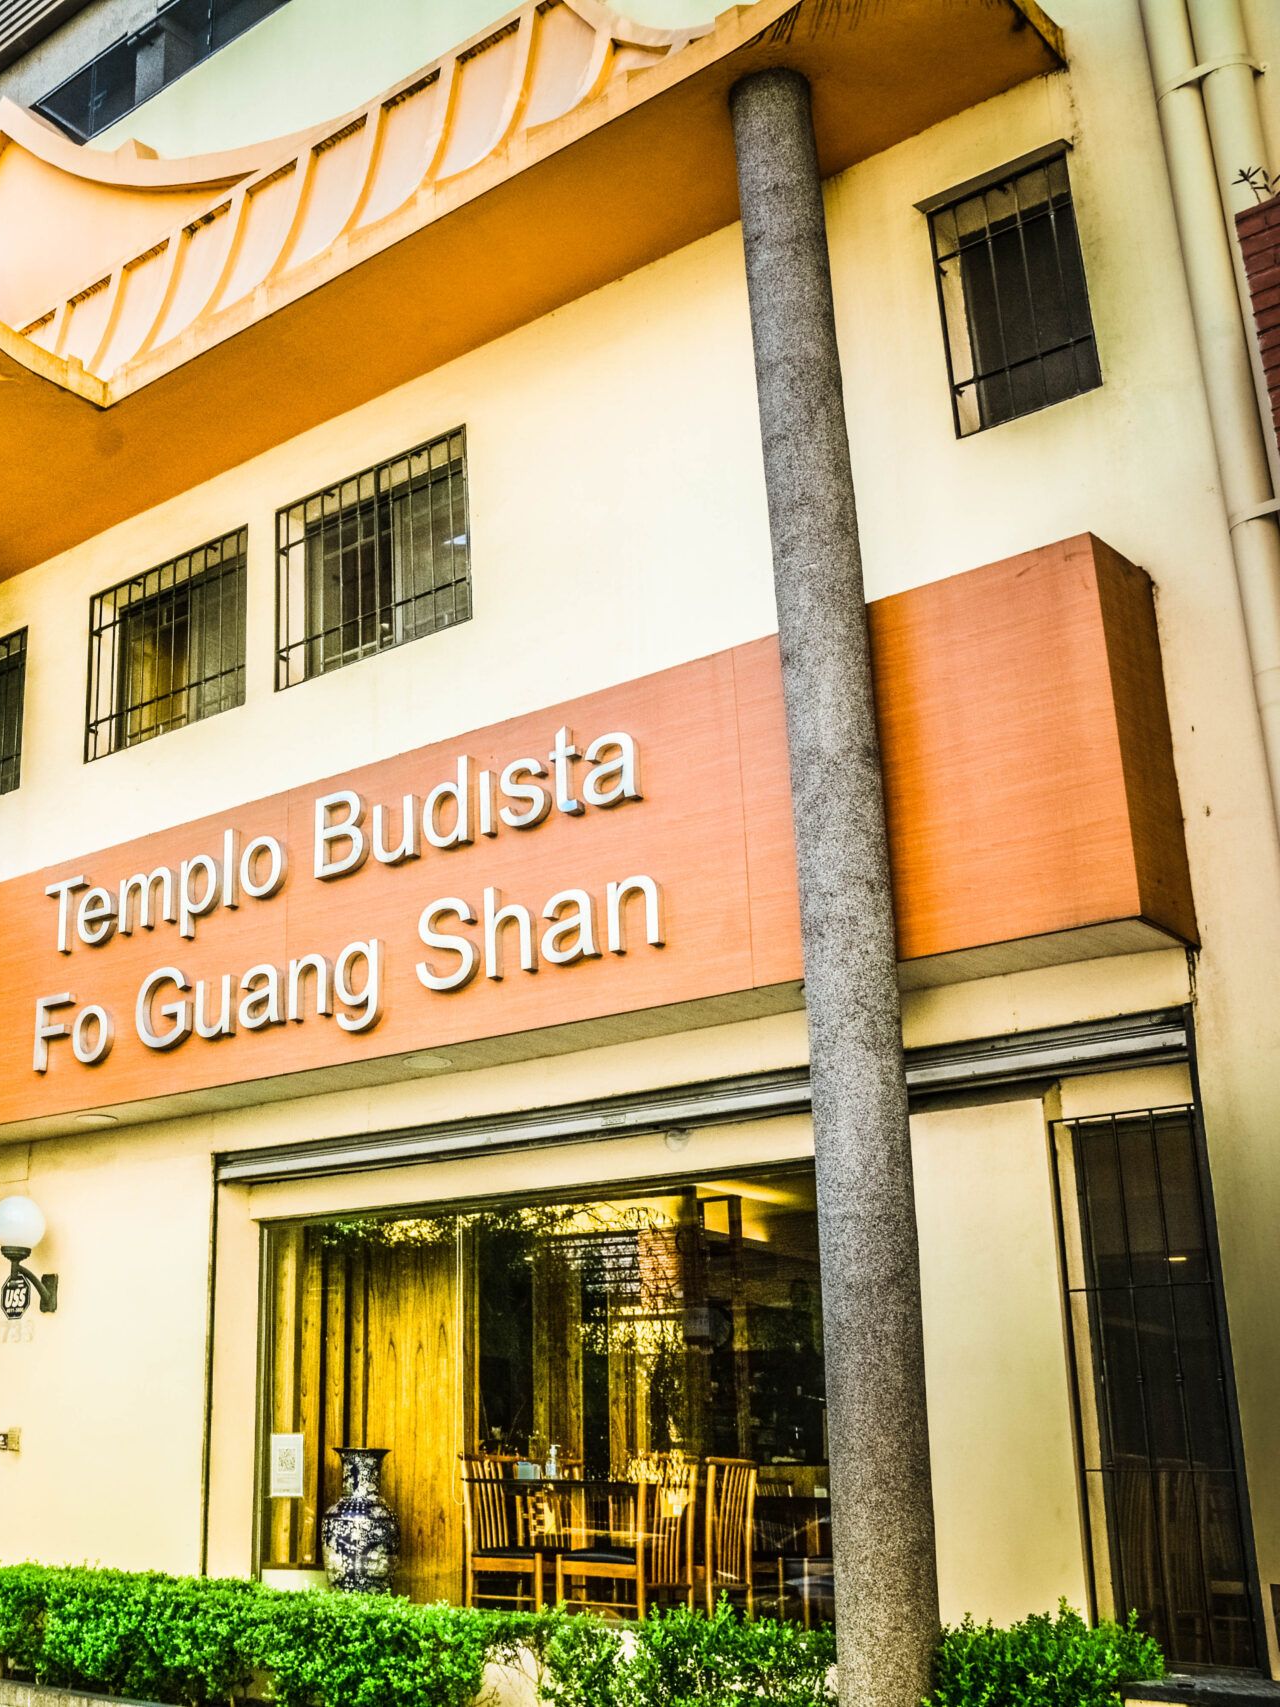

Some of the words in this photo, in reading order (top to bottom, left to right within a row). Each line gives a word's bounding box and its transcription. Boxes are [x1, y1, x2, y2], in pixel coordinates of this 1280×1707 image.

[45, 828, 288, 954] Templo
[314, 725, 643, 882] Budista
[32, 992, 114, 1074] Fo
[135, 938, 386, 1051] Guang
[416, 875, 666, 993] Shan
[4, 1287, 27, 1308] USS
